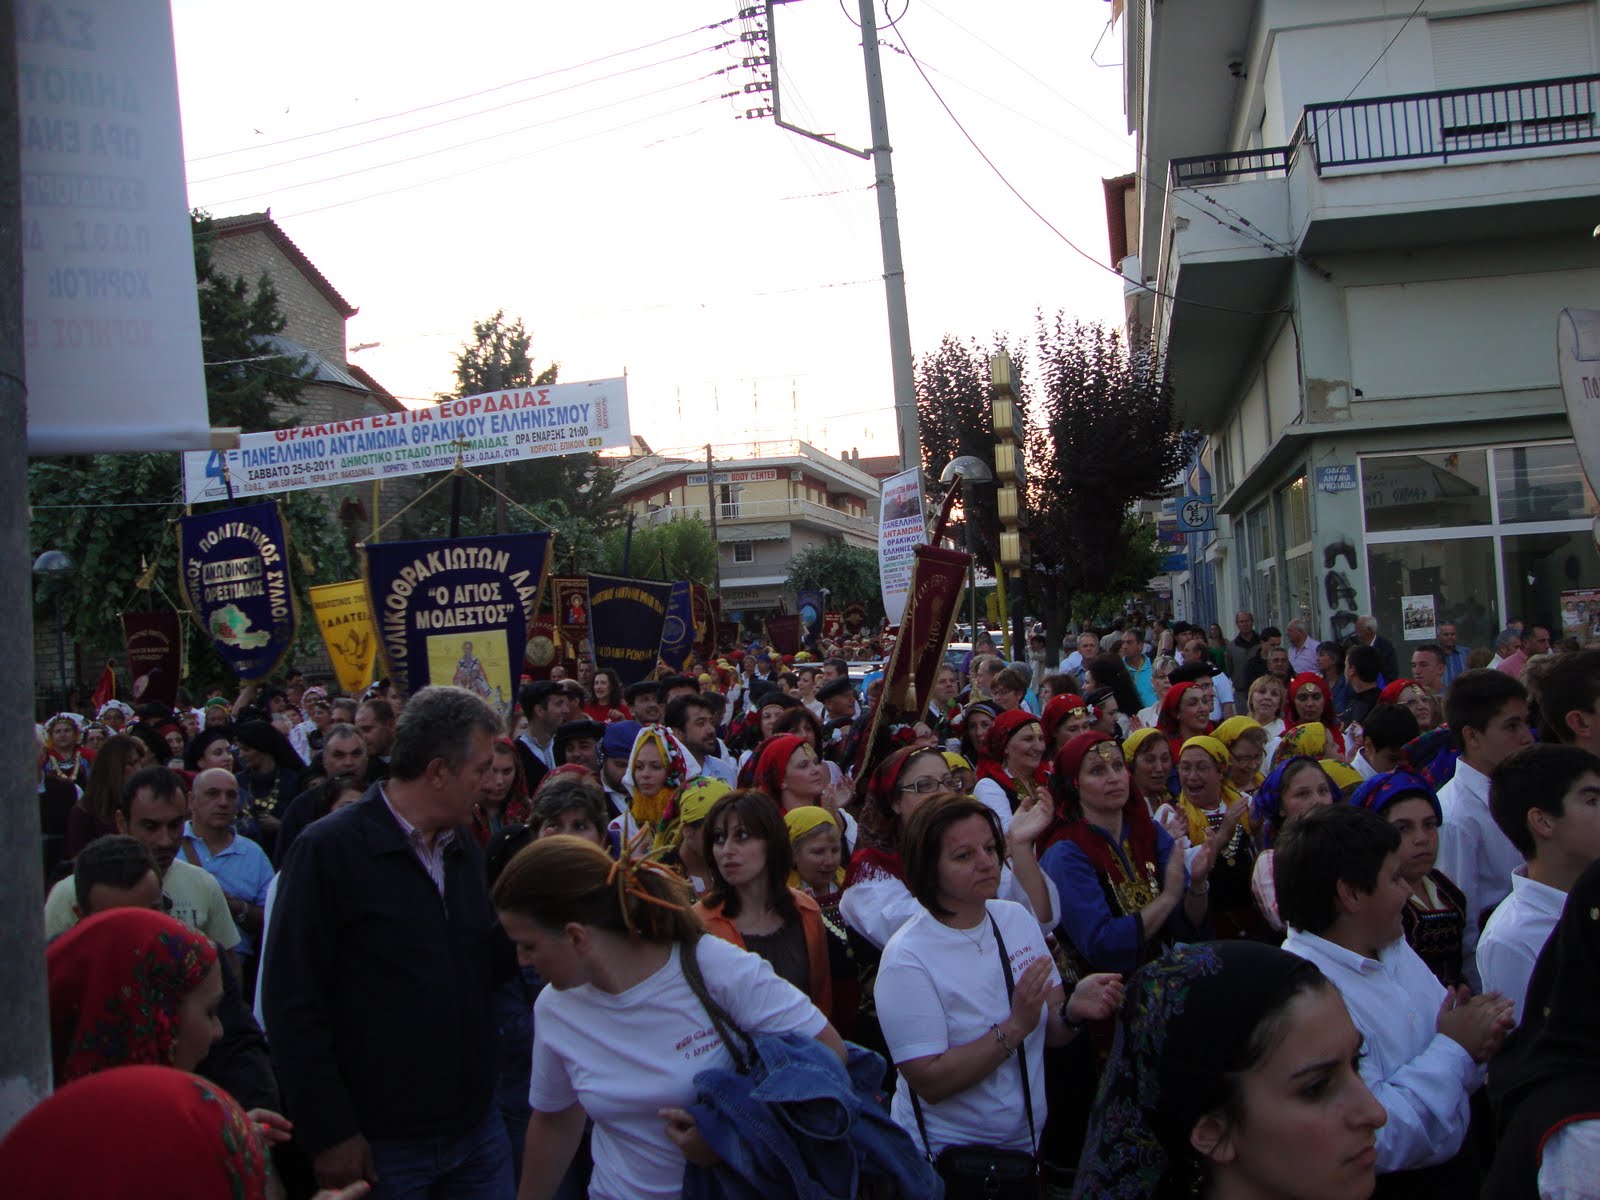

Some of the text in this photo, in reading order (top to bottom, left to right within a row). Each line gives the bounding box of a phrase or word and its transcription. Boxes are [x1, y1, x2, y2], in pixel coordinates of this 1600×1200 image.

[440, 388, 551, 420] ΕΟΡΔΑΙΑΣ
[241, 439, 326, 470] ΠΑΝΕΛΛΗΝΙΟ
[329, 427, 408, 455] ΑΝΤΑΜΩΜΑ
[411, 416, 486, 445] ΘΡΑΚΙΚΟΥ
[491, 403, 590, 434] ΕΛΛΗΝΙΣΜΟΥ
[248, 464, 290, 481] ΣΑΒΒΑΤΟ
[292, 460, 336, 476] 25-6-2011
[340, 452, 392, 469] ΔΗΜΟΤΙΚΟ
[395, 446, 431, 462] ΣΤΑΔΙΟ
[515, 433, 531, 445] ΩΡΑ
[532, 428, 566, 444] ΕΝΑΡΞΗΣ
[569, 426, 589, 438] 21:00
[731, 470, 776, 482] BODY CENTER
[883, 516, 922, 530] ΠΑΝΕΛΛΗΝΙΟ
[883, 525, 923, 538] ΑΝΤΑΜΩΜΑ
[887, 535, 919, 546] ΘΡΑΚΙΚΟΥ
[454, 582, 502, 604] ΑΓΙΟΣ
